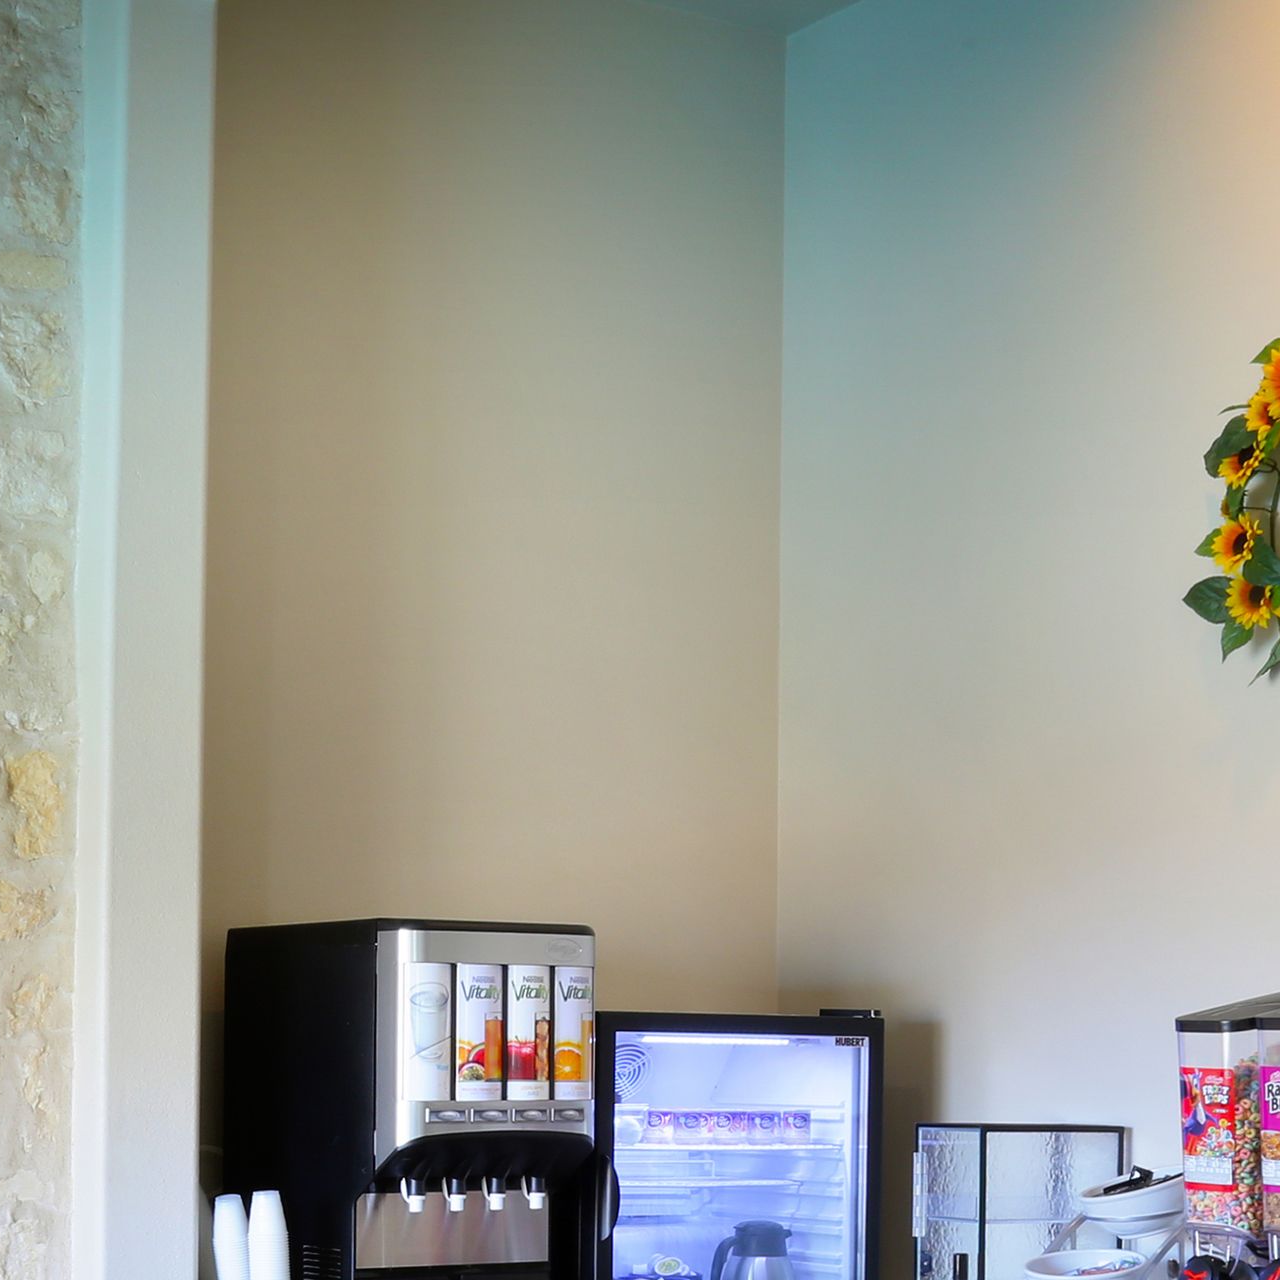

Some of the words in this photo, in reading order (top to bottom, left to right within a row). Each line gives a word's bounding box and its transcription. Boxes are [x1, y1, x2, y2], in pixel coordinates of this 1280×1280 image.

[461, 980, 500, 1003] Vitality
[511, 980, 548, 1003] Vitality
[835, 1037, 866, 1047] HUBERT
